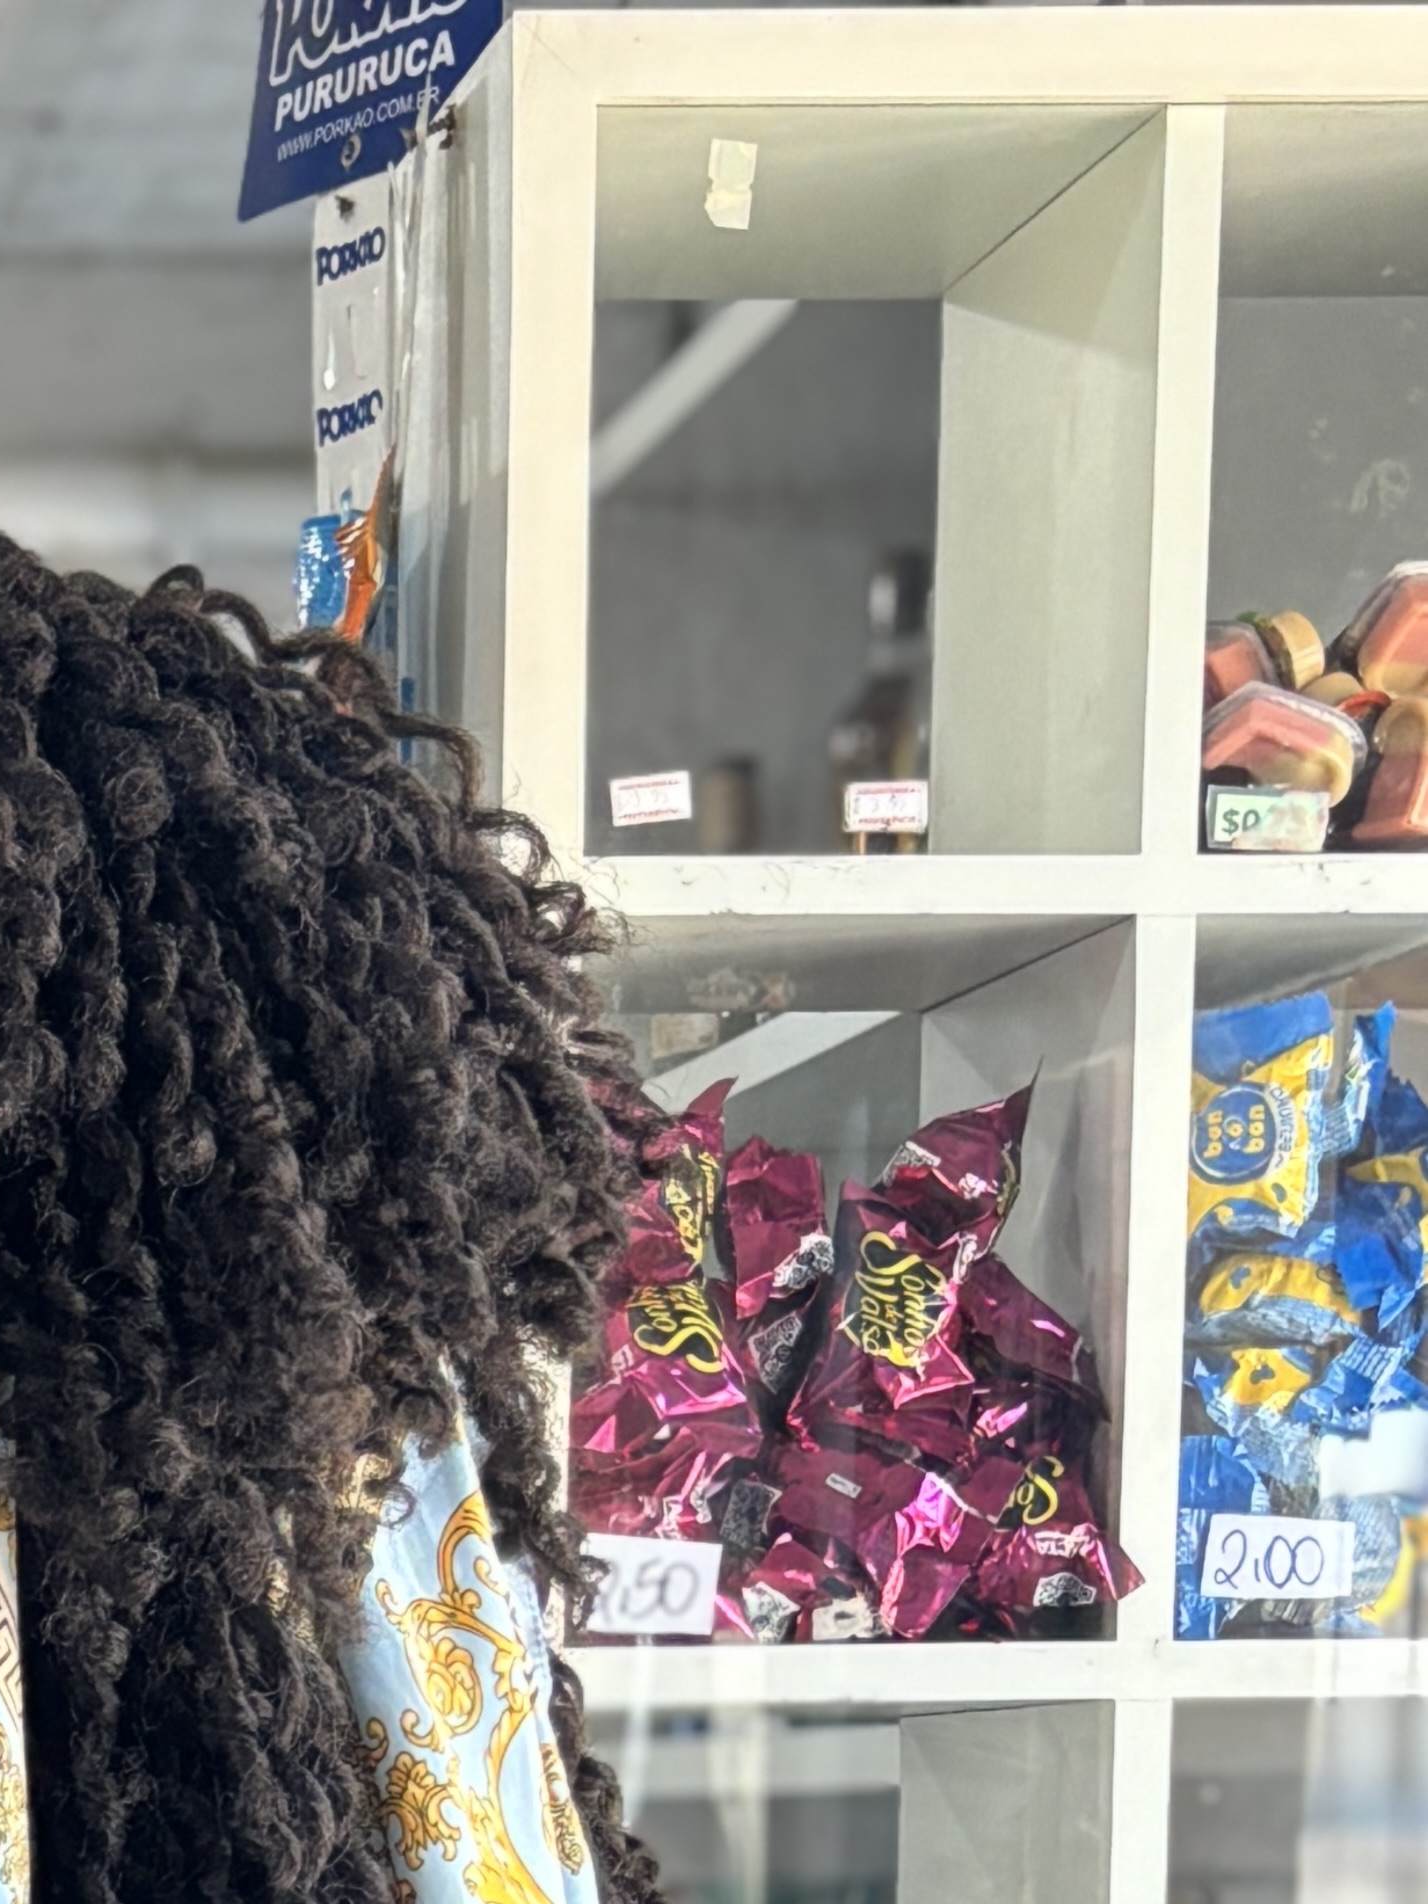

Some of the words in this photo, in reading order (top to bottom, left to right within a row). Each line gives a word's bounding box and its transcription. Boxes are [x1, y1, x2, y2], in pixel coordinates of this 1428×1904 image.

[275, 30, 456, 133] PURURUCA
[1202, 1109, 1223, 1159] bon
[1243, 1104, 1266, 1154] bon
[1214, 1529, 1324, 1590] 2,00
